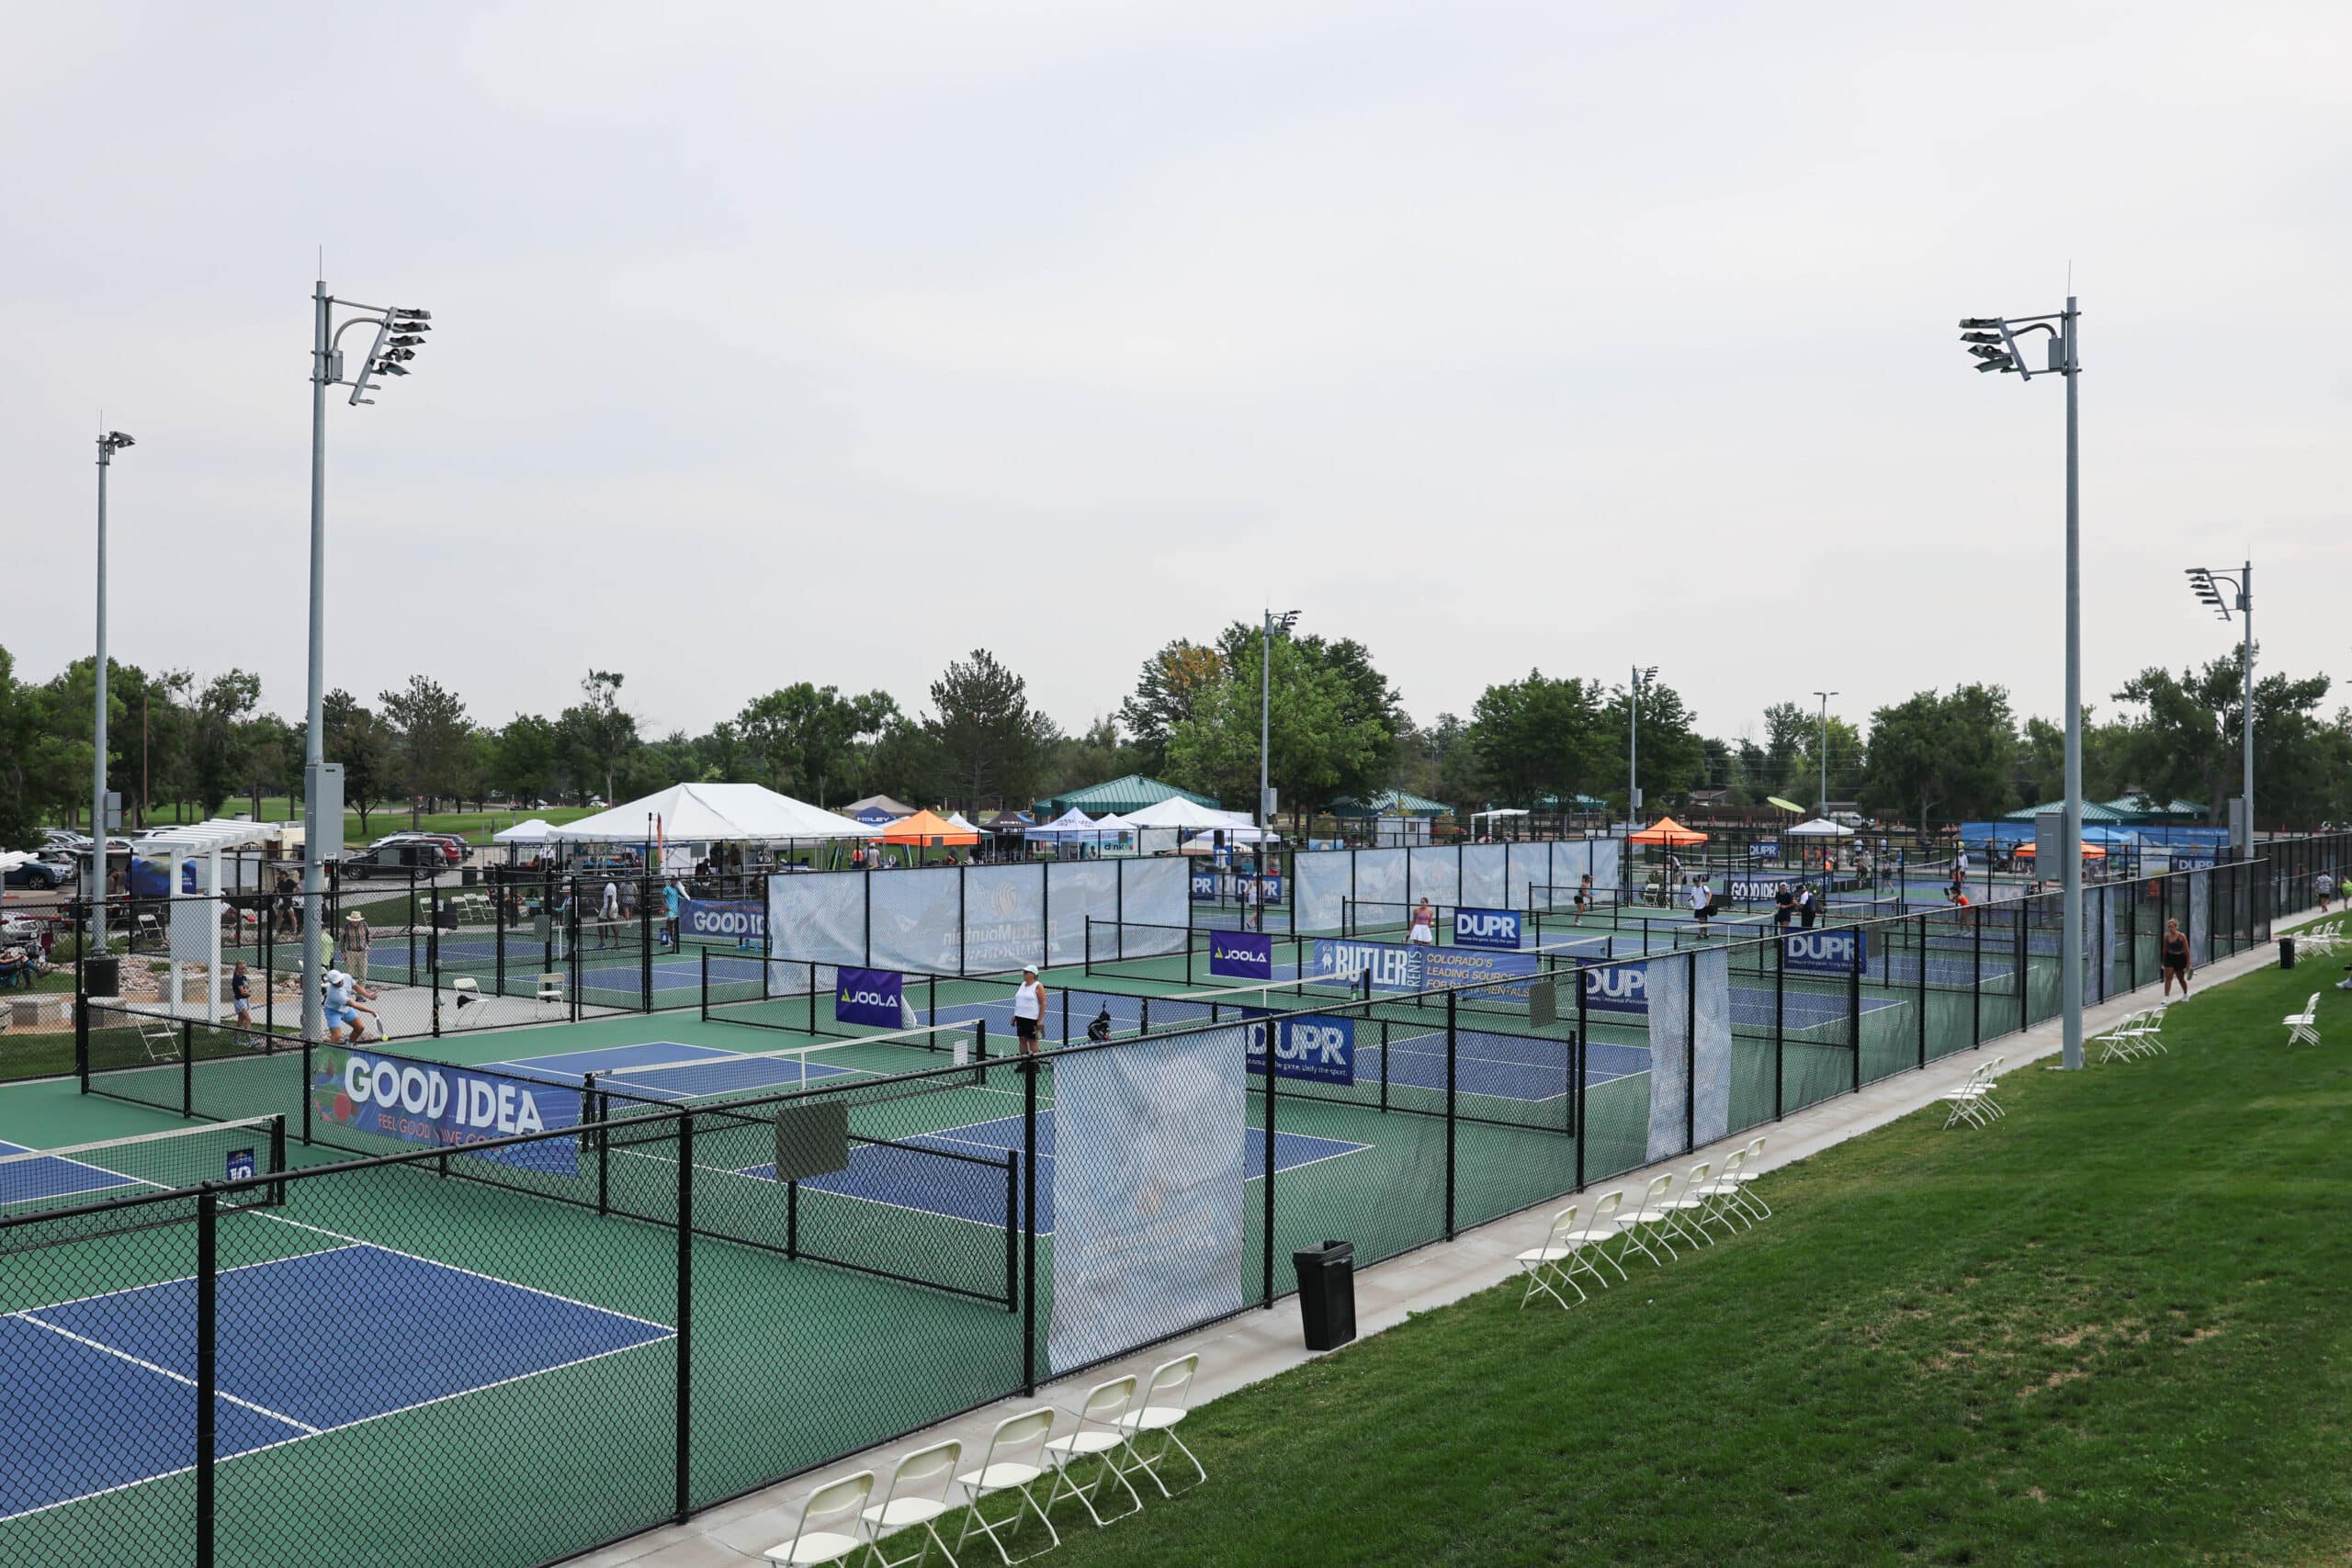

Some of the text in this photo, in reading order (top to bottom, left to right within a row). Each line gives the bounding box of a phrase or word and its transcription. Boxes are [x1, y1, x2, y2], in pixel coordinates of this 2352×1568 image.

[1749, 845, 1776, 855] DUPR
[1193, 877, 1213, 894] PR
[693, 910, 749, 934] GOOD
[1456, 913, 1517, 938] DUPR
[1224, 949, 1267, 963] JOOLA
[1426, 953, 1493, 968] COLORADO'S
[1787, 936, 1861, 962] DUPR
[1335, 945, 1408, 986] BUTLER
[1407, 951, 1422, 987] RENTS
[1426, 966, 1470, 979] LEADING
[1586, 967, 1648, 998] DUP
[851, 991, 899, 1008] JOOLA
[1248, 1021, 1347, 1066] DUPR
[345, 1056, 545, 1135] GOOD IDEA
[378, 1113, 398, 1131] FEEL
[399, 1118, 430, 1139] GOOD
